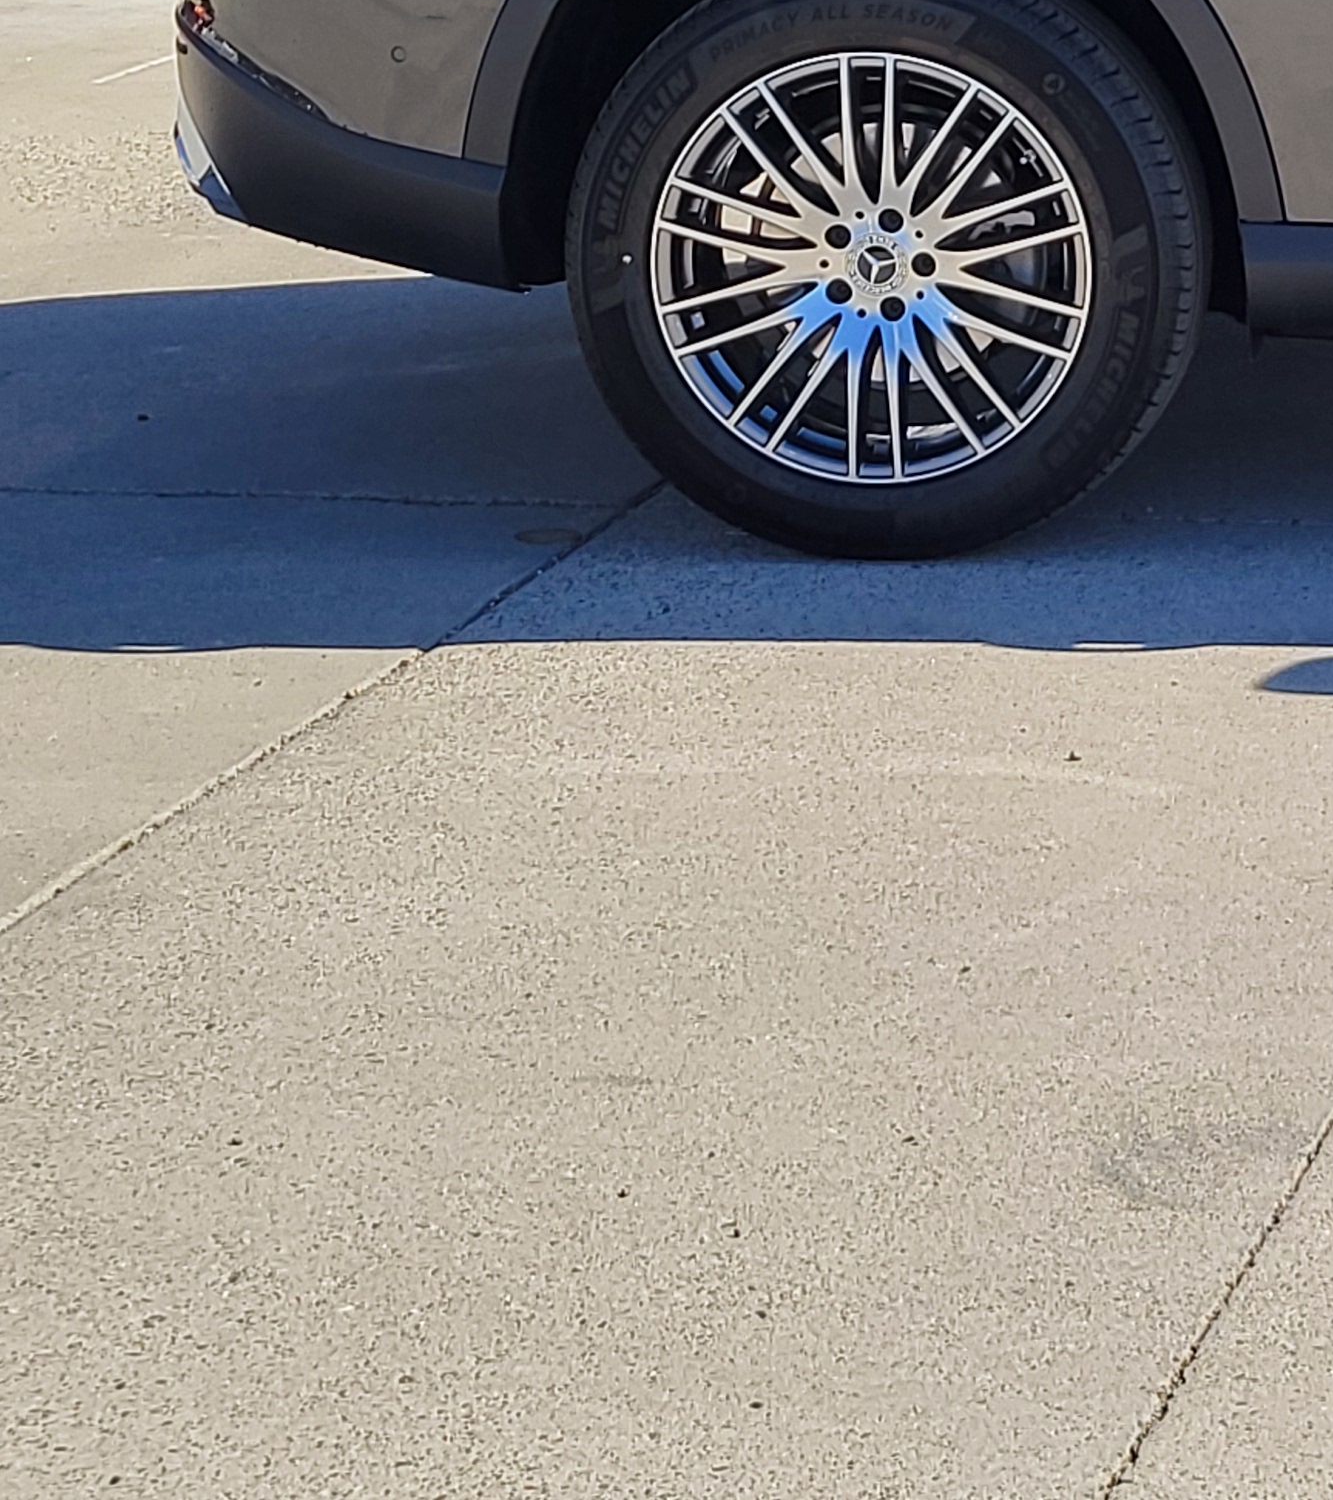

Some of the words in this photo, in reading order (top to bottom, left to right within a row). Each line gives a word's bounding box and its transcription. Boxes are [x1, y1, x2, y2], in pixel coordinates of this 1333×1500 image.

[707, 10, 801, 60] PRIMACY
[809, 2, 850, 24] ALL
[861, 3, 953, 32] SEASON
[596, 66, 693, 229] MICHELIN
